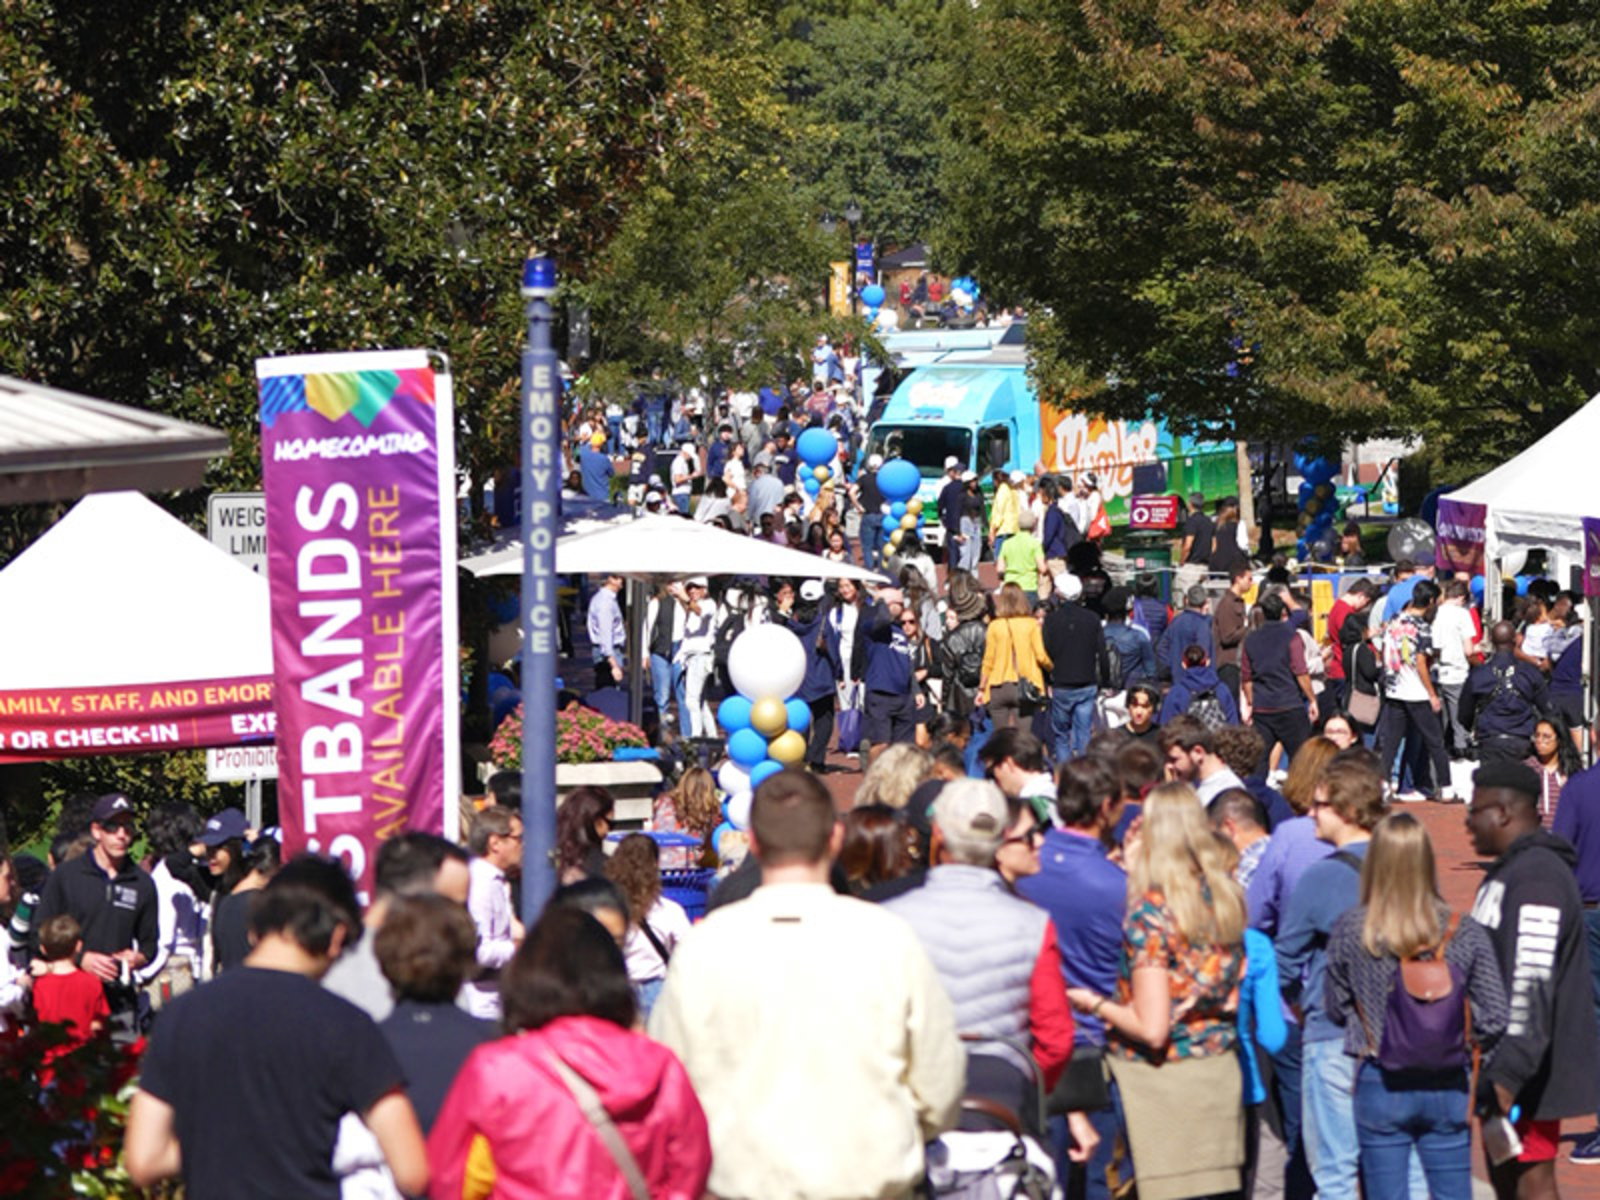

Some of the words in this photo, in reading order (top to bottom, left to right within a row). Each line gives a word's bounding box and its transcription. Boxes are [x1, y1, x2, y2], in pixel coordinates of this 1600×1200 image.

[529, 365, 553, 492] EMORY
[273, 431, 429, 461] HOMECOMING
[218, 507, 267, 527] WEIG
[230, 535, 267, 555] LIMI
[367, 484, 401, 598] HERE
[530, 501, 552, 653] POLICE
[71, 691, 144, 713] STAFF,
[150, 689, 198, 709] AND
[204, 682, 275, 705] EMOR
[295, 482, 369, 906] STBANDS
[11, 731, 49, 750] OR
[54, 724, 179, 747] CHECK-IN
[215, 746, 277, 768] Prohibit
